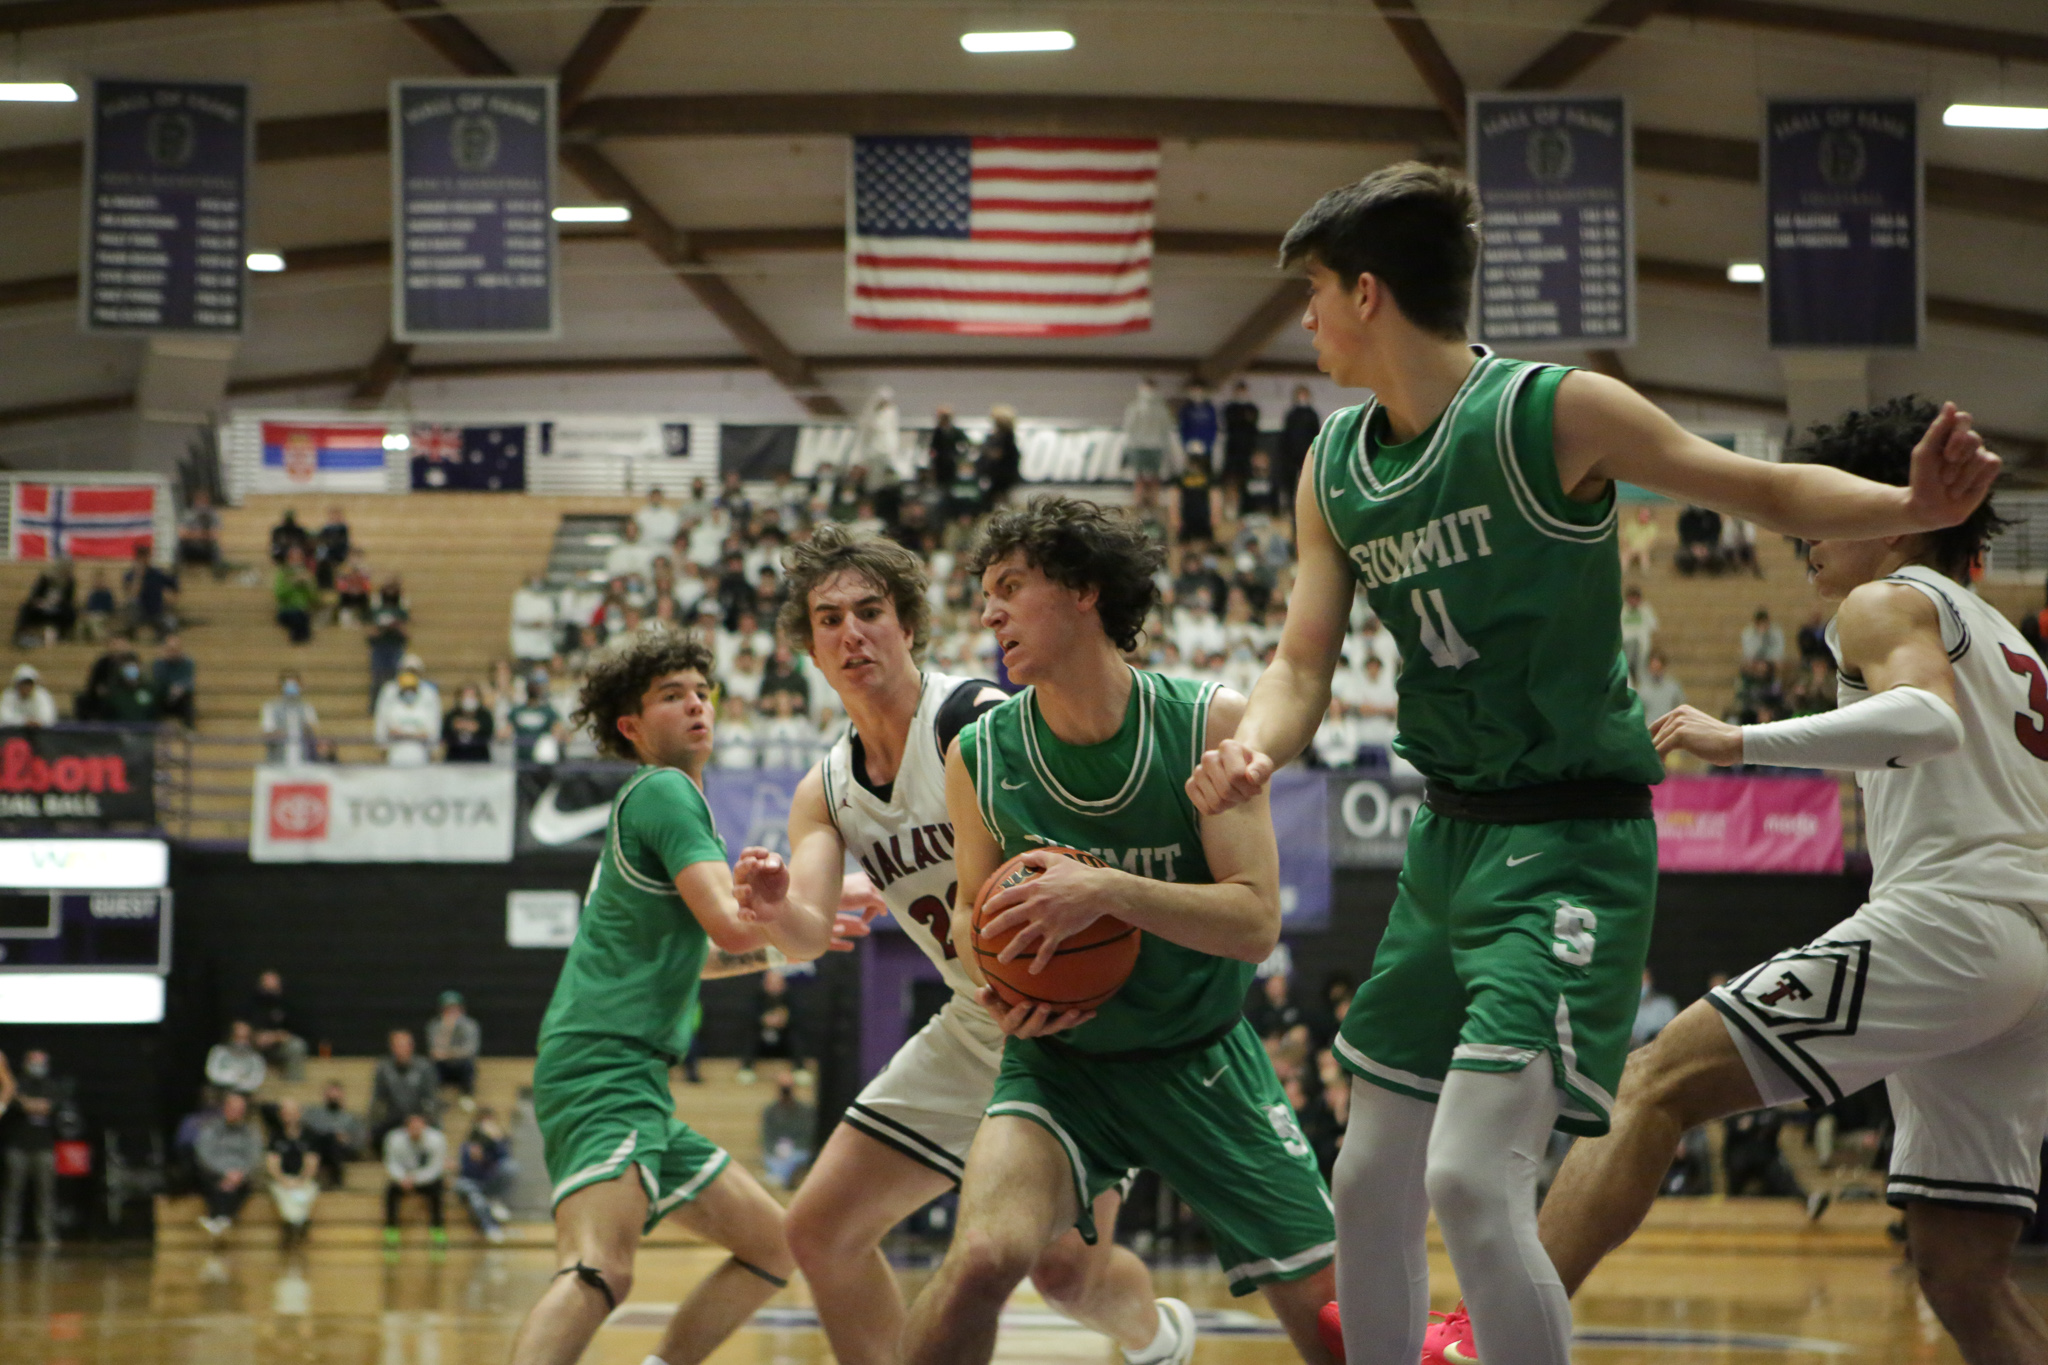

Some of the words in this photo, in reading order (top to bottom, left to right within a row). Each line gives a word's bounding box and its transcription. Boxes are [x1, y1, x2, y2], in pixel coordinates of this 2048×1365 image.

[1349, 504, 1493, 589] SUMMIT
[0, 737, 130, 793] lson
[347, 797, 498, 828] TOYOTA
[1341, 780, 1420, 839] On
[908, 880, 958, 961] 2
